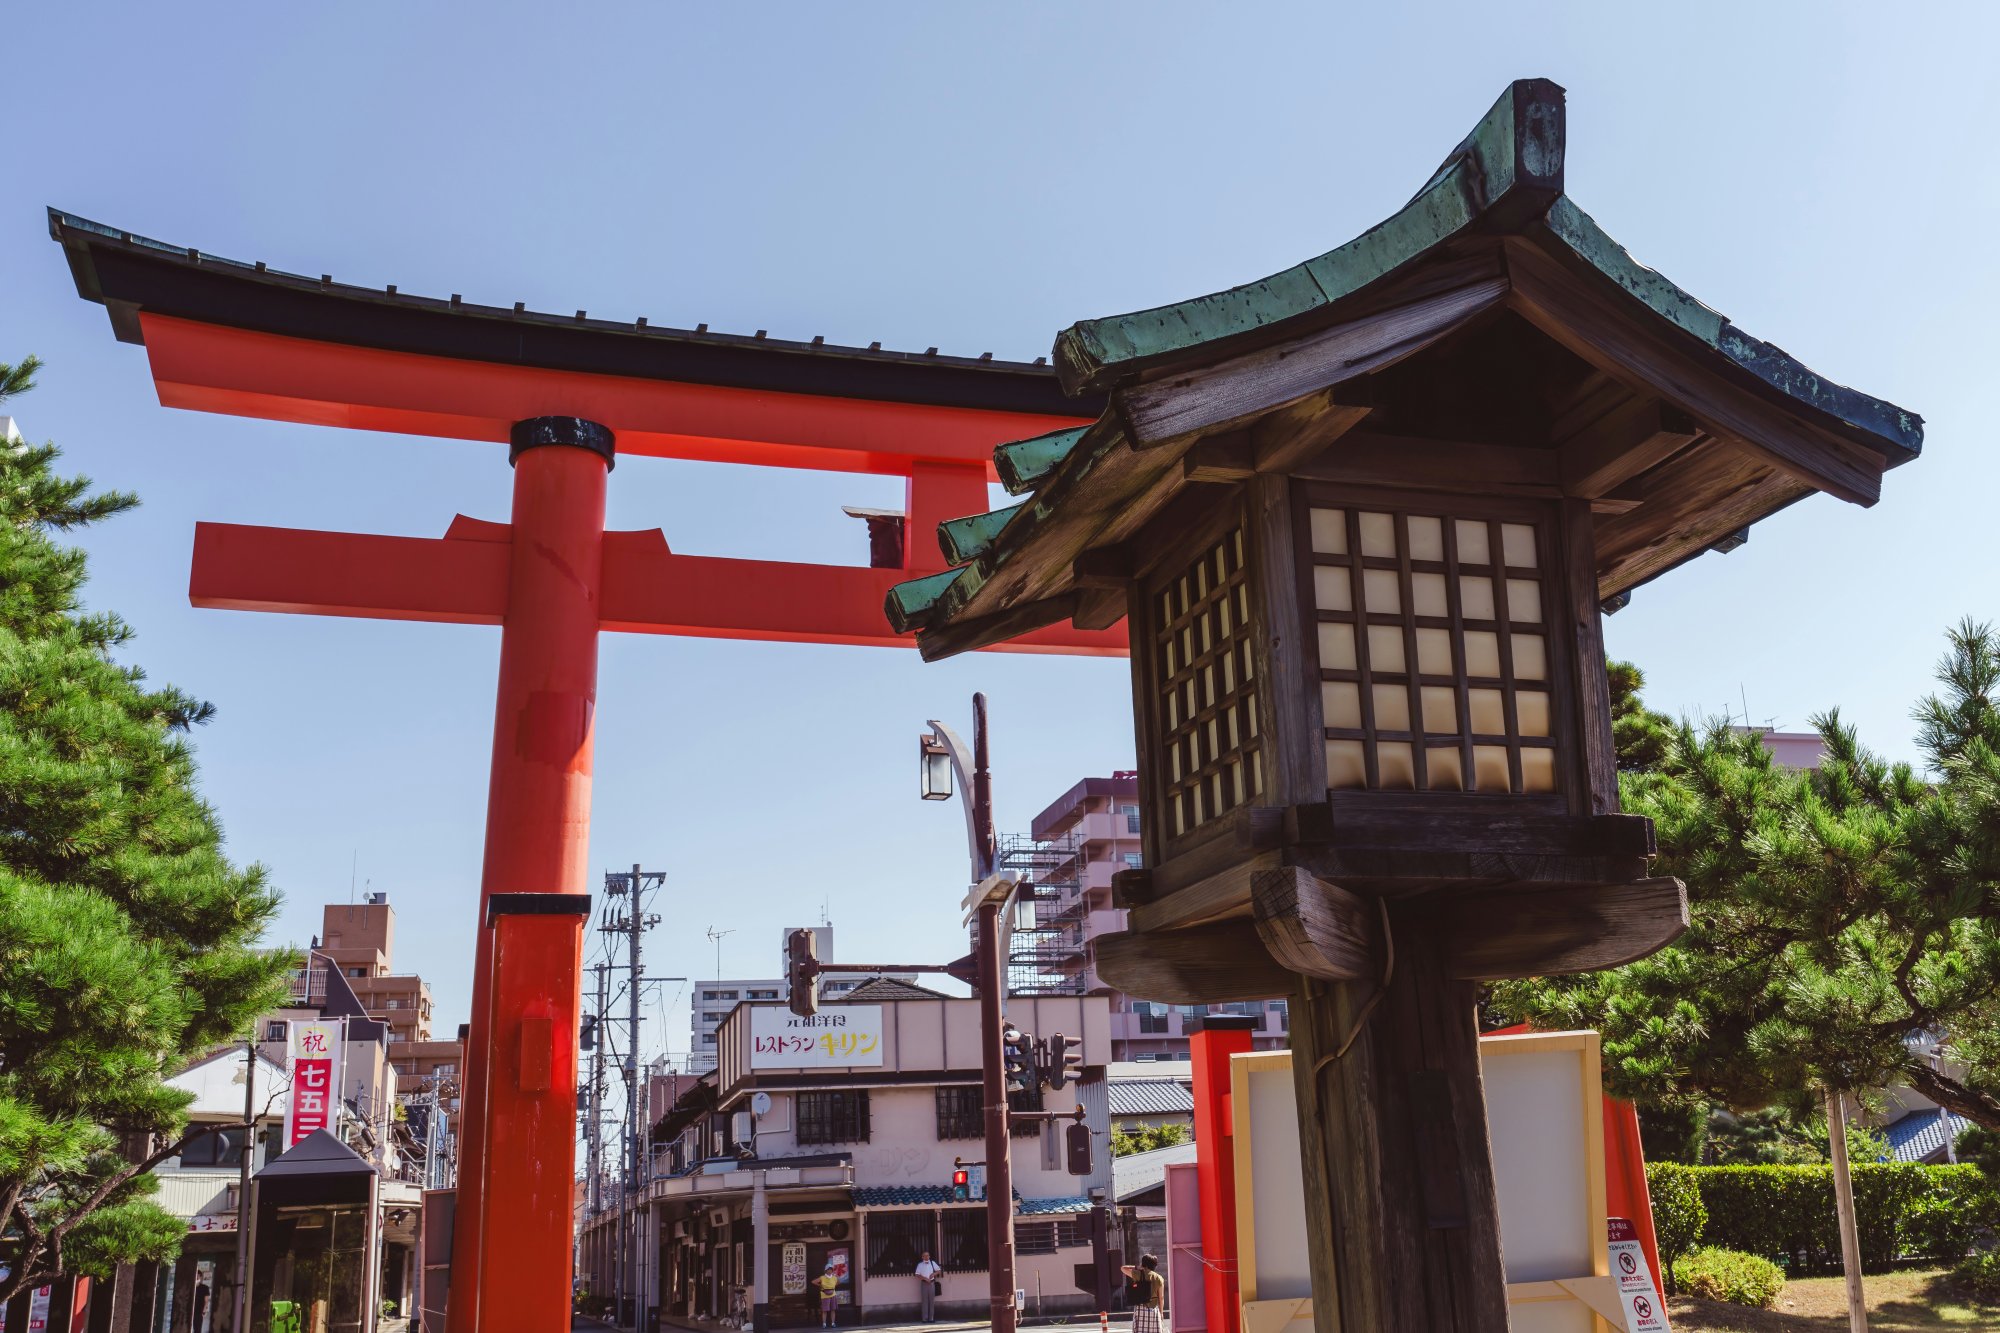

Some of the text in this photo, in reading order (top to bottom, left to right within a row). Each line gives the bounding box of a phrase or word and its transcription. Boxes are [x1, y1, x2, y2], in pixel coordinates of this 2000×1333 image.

[302, 1030, 328, 1053] 祝
[755, 1032, 879, 1057] レストラン キリン
